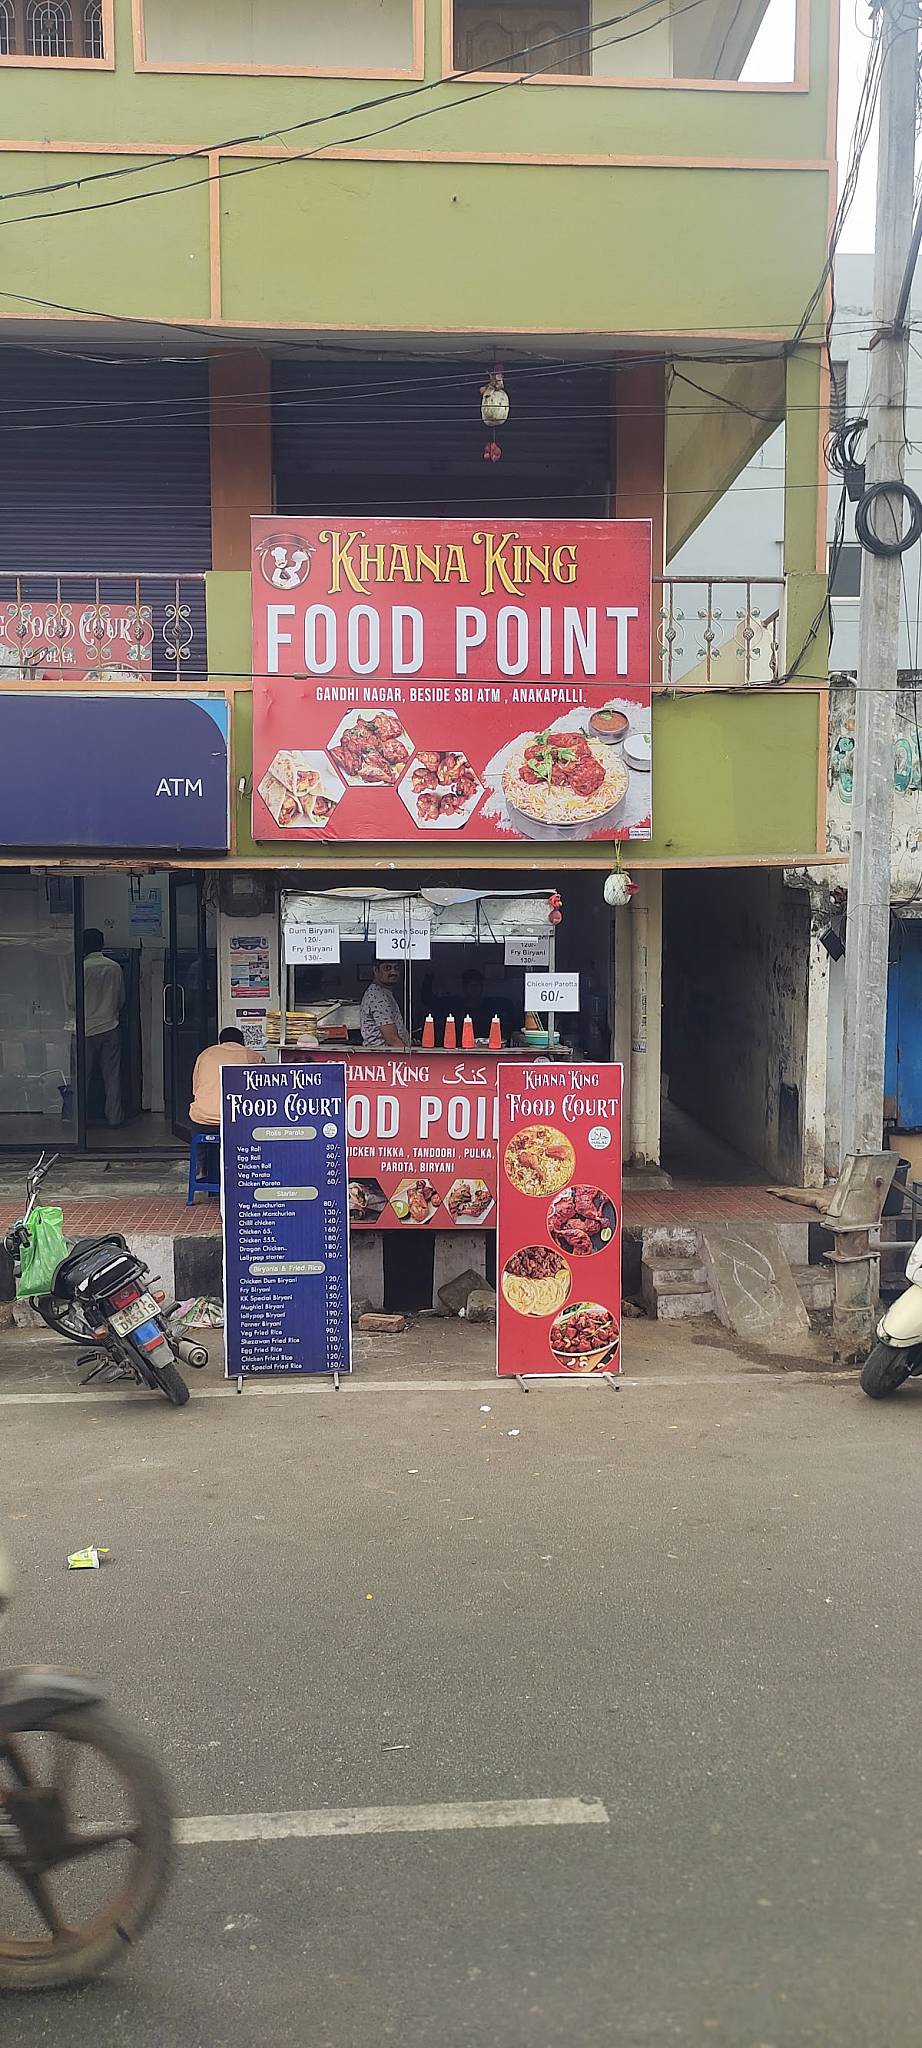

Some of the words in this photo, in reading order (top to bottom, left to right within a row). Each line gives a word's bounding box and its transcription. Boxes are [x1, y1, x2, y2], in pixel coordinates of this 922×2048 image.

[319, 530, 469, 596] KHANA
[472, 531, 578, 596] KING
[266, 604, 424, 674] FOOD
[455, 605, 638, 675] POINT
[316, 687, 358, 701] GANDHI
[364, 688, 406, 704] NAGAR,
[410, 688, 450, 702] BESIDE
[454, 688, 472, 702] SBI
[477, 688, 500, 702] ATM
[512, 688, 586, 702] ANAKAPALLI.
[156, 778, 203, 796] ATM
[410, 928, 428, 936] Soup
[392, 938, 416, 950] 30/-
[540, 990, 564, 1002] 60/-
[243, 1070, 288, 1090] KHANA
[290, 1070, 322, 1090] KING
[346, 1065, 386, 1082] HANA
[388, 1062, 430, 1086] KING
[522, 1070, 566, 1090] KHANA
[568, 1070, 599, 1090] KING
[226, 1094, 277, 1122] FOOD
[284, 1093, 342, 1122] COURT
[348, 1094, 400, 1138] OD
[420, 1096, 498, 1140] POI
[506, 1094, 554, 1122] FOOD
[562, 1094, 618, 1122] COURT
[346, 1147, 374, 1156] ICKEN
[378, 1148, 404, 1158] TIKKA
[413, 1148, 456, 1158] TANDOORI
[464, 1148, 494, 1159] PULKA,
[381, 1162, 416, 1172] PAROTA,
[420, 1162, 454, 1172] BIRYANI
